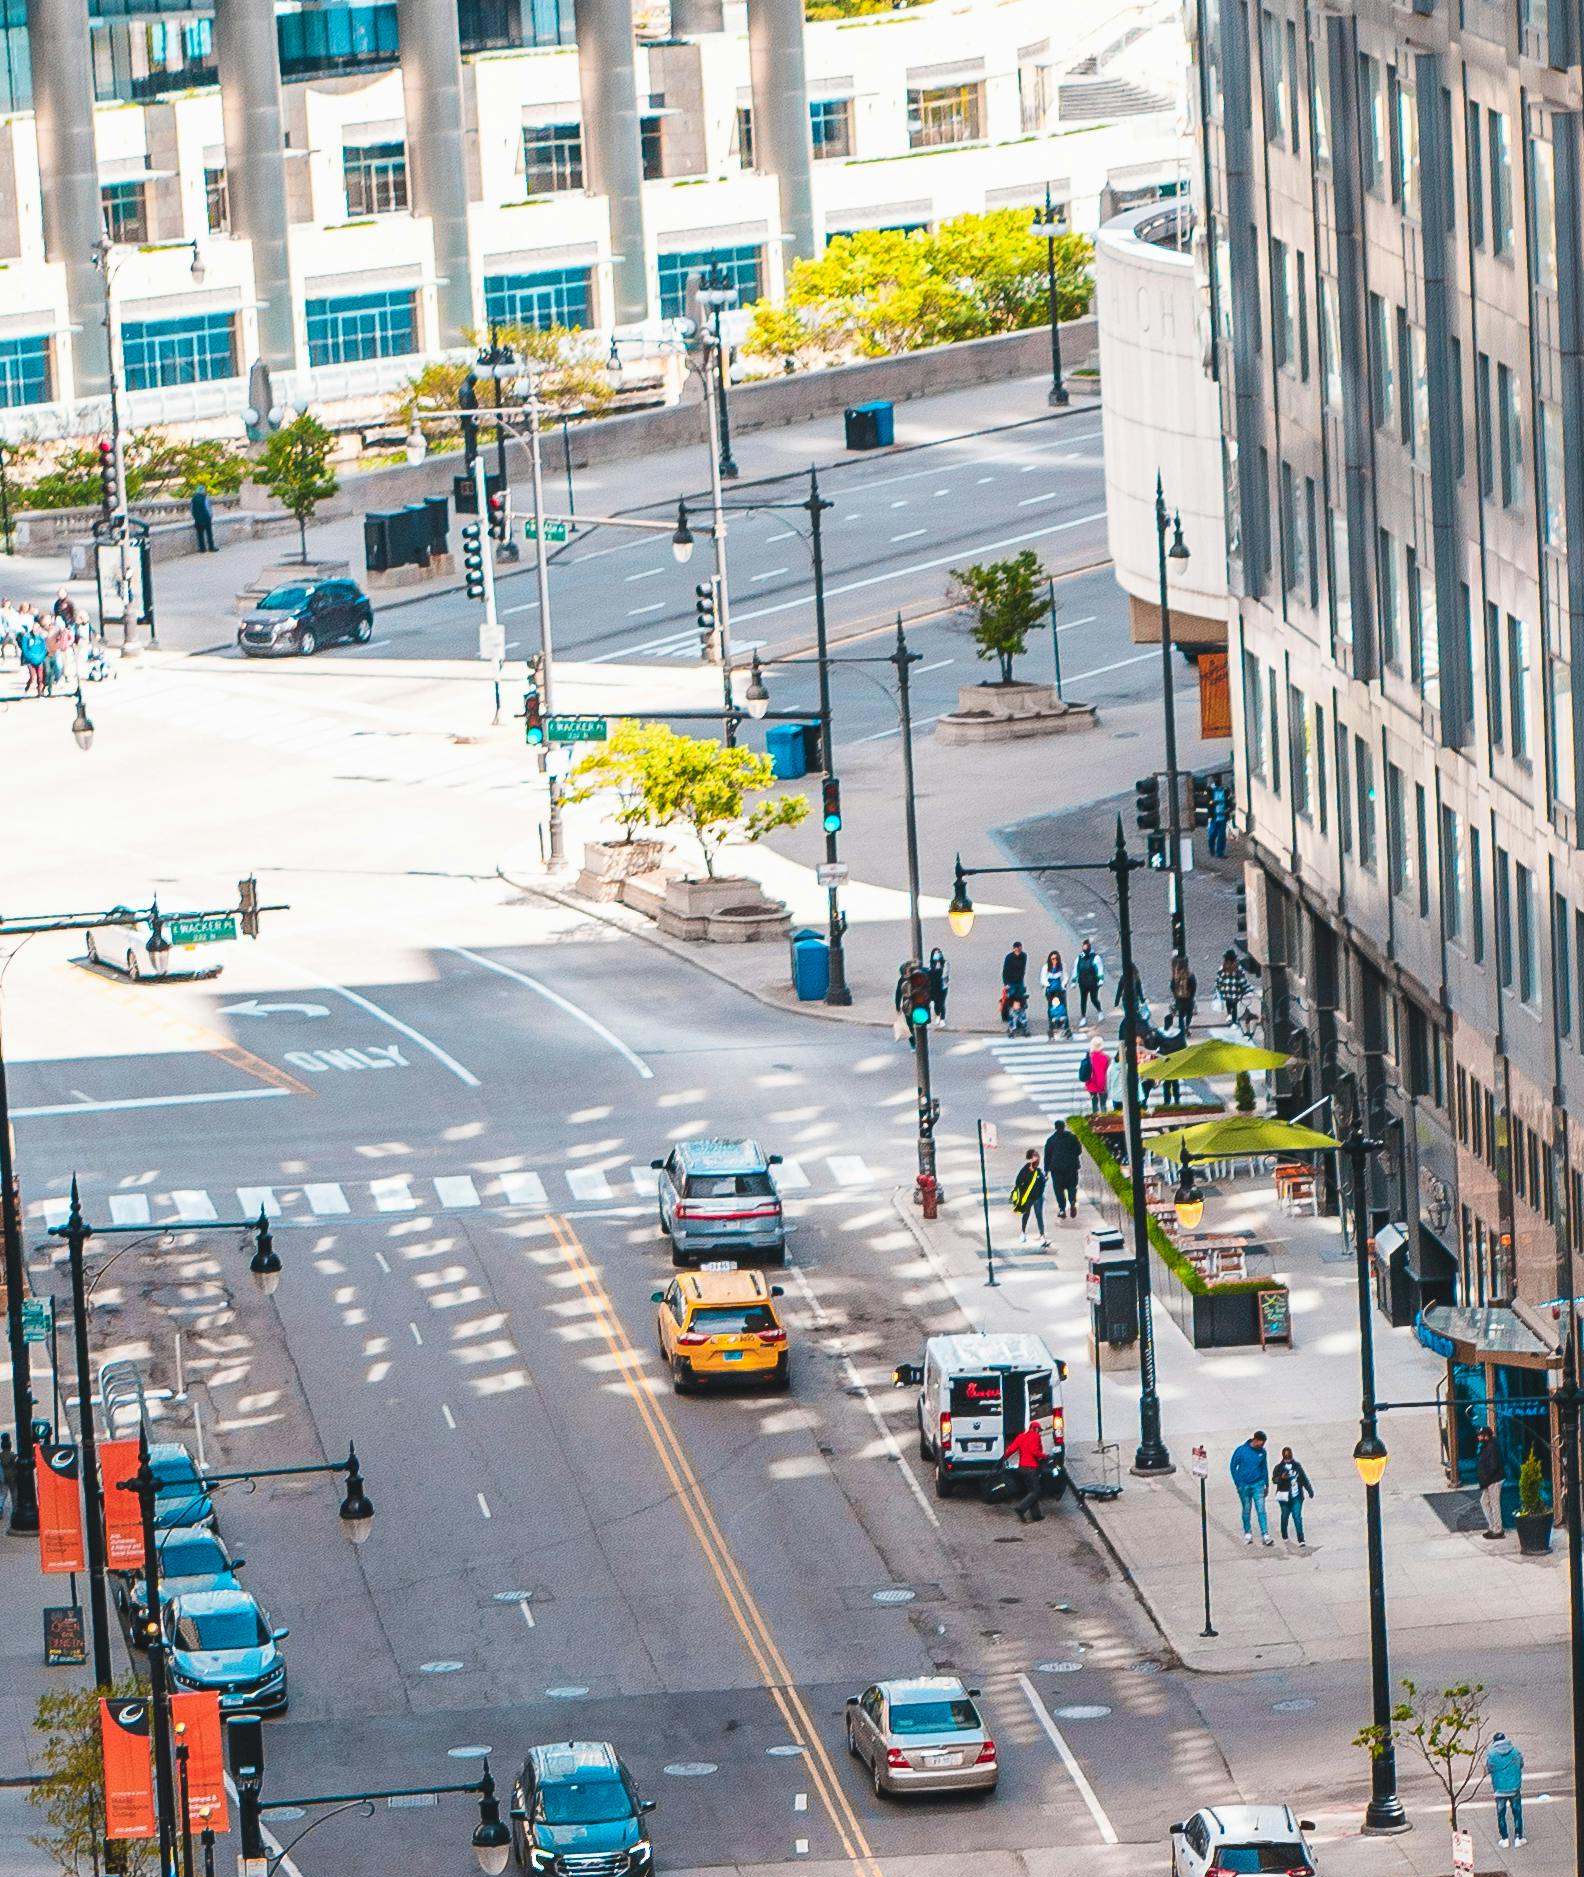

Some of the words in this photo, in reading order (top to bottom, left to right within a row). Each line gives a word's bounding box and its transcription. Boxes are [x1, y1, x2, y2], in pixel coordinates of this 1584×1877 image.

[557, 722, 593, 732] WACKER
[180, 921, 221, 933] WACKER
[283, 1045, 410, 1072] ONLY
